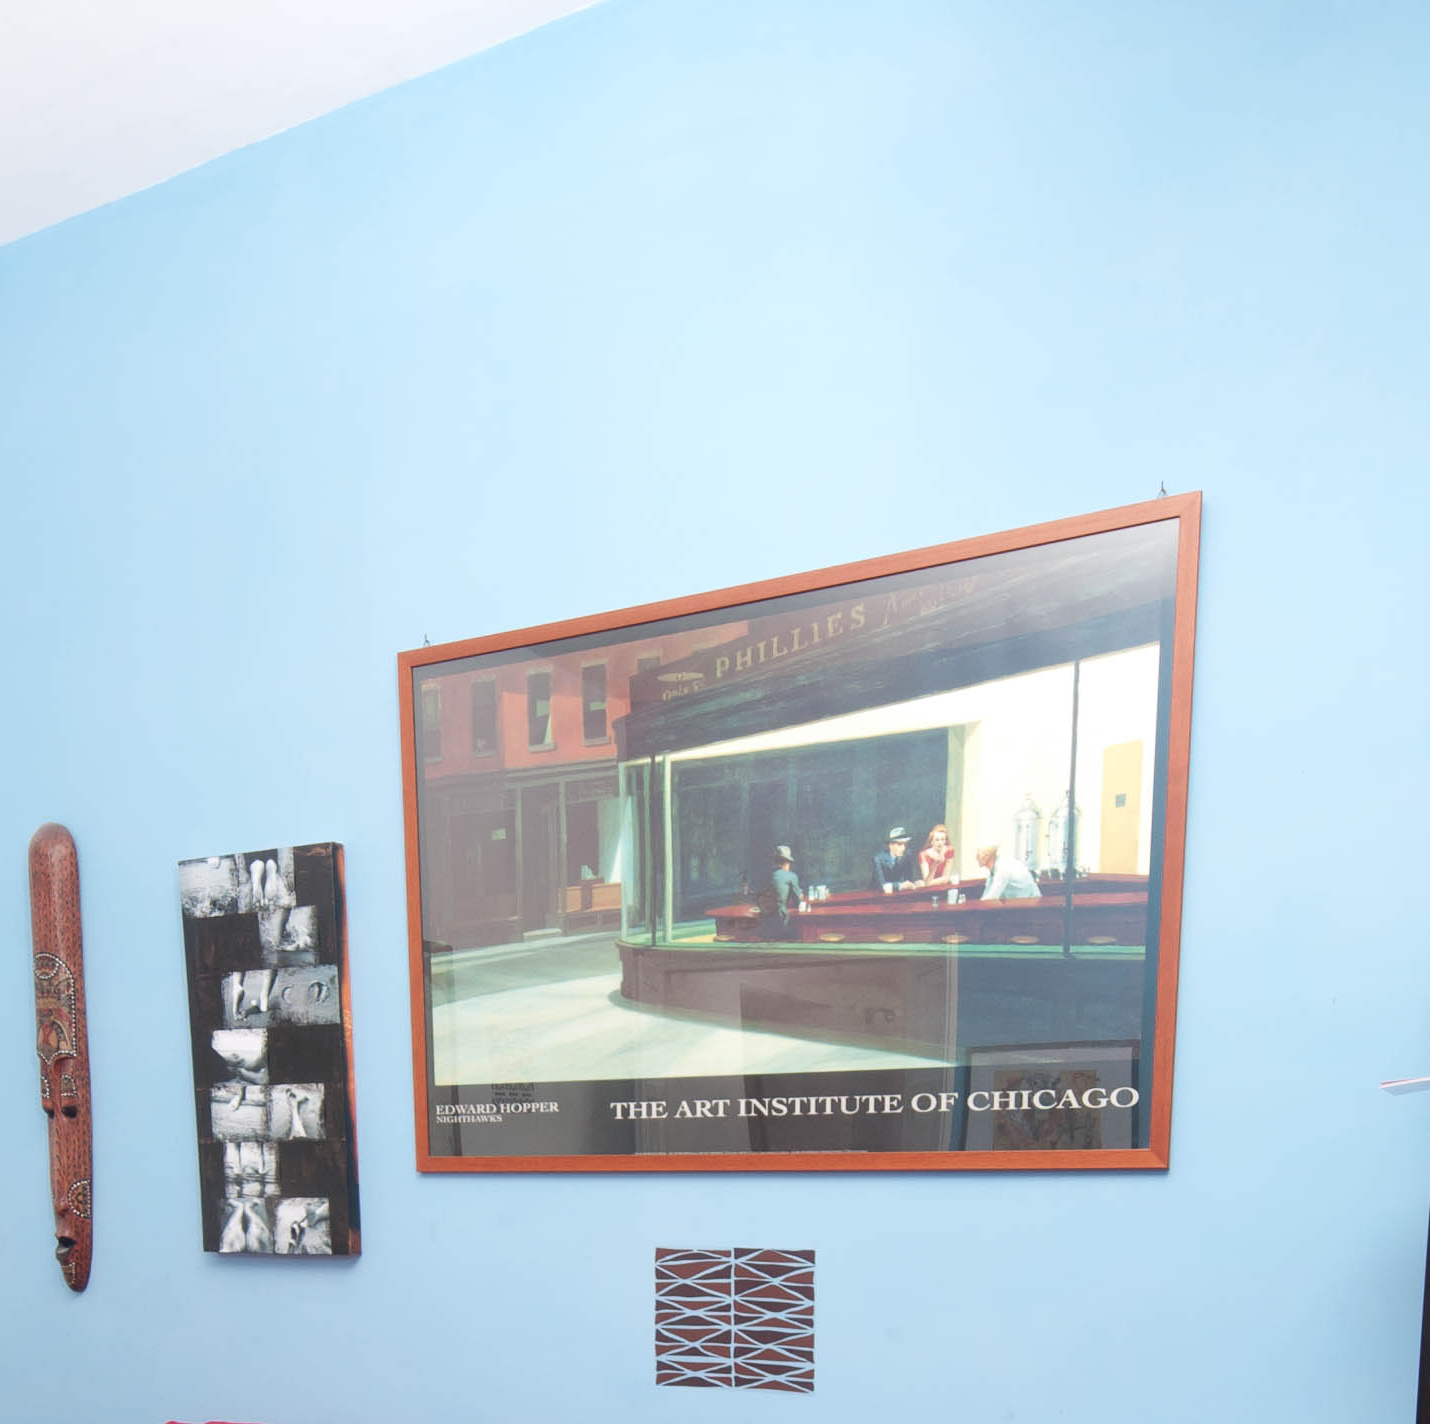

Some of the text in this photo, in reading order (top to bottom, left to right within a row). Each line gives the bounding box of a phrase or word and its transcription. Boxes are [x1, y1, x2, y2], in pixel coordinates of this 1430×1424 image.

[715, 600, 867, 679] PHILLIES
[436, 1102, 559, 1115] EDWARD HOPPER
[610, 1087, 1140, 1120] THE ART INSTITUTE OF CHICAGO
[436, 1115, 503, 1124] NIGHTHAWKS
